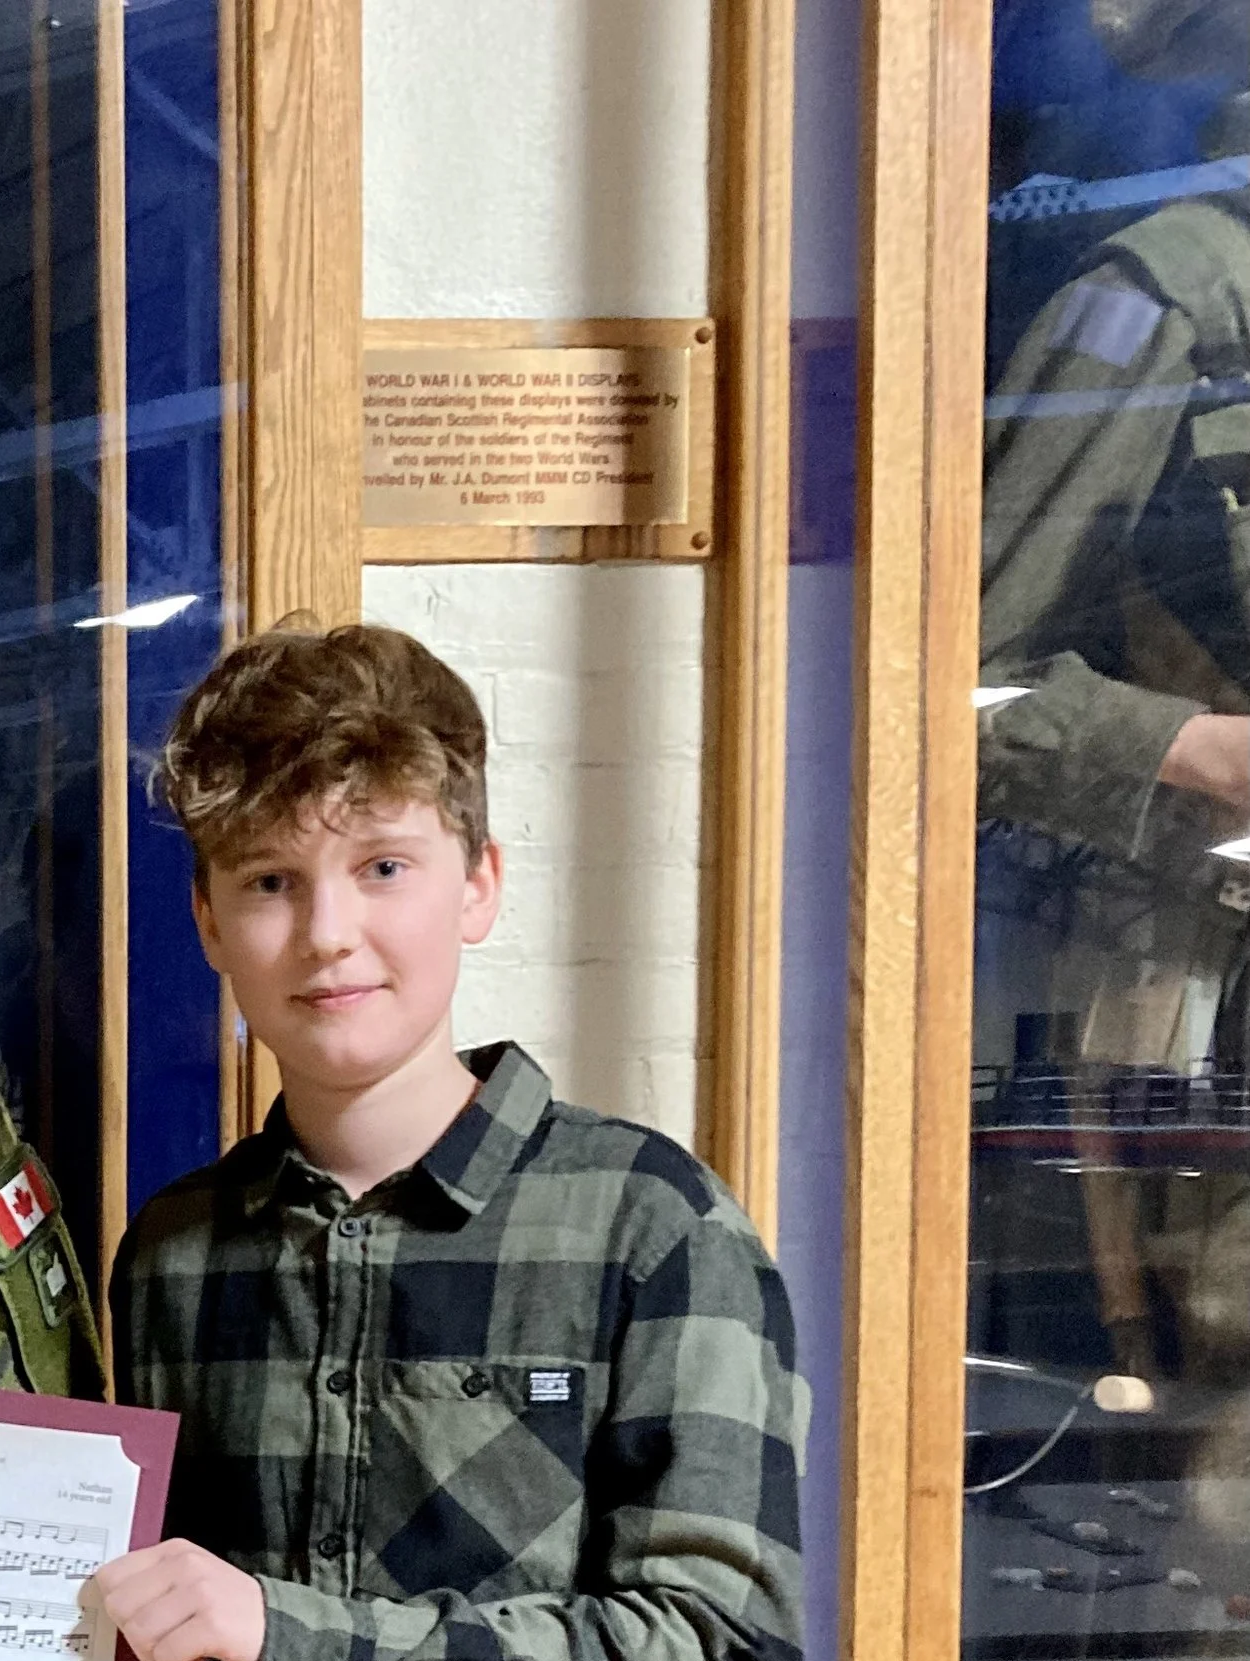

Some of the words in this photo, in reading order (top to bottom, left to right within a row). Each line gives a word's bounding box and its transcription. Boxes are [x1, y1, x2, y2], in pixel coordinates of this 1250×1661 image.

[365, 374, 415, 387] WORLD
[419, 374, 450, 387] WAR
[454, 374, 459, 387] I
[463, 374, 472, 387] &
[477, 374, 525, 387] WORLD
[530, 374, 561, 387] WAR
[566, 374, 573, 387] II
[578, 373, 639, 387] DISPLAYS
[362, 394, 407, 407] abinets
[411, 395, 476, 410] containing
[481, 395, 515, 407] these
[519, 393, 571, 410] displays
[575, 396, 607, 406] were
[664, 393, 679, 410] by
[363, 412, 380, 427] he
[385, 413, 442, 427] Canadian
[447, 412, 498, 427] Scottish
[502, 411, 573, 430] Regimental
[577, 412, 649, 426] Association
[372, 432, 384, 447] in
[390, 432, 432, 447] honour
[437, 432, 450, 447] of
[455, 432, 475, 447] the
[480, 432, 529, 447] soldiers
[533, 432, 547, 447] of
[551, 432, 570, 446] the
[575, 431, 634, 449] Regiment
[393, 453, 419, 467] who
[424, 452, 465, 467] served
[469, 452, 481, 466] in
[486, 452, 505, 467] the
[509, 452, 533, 466] two
[537, 451, 574, 466] World
[362, 472, 405, 487] nveiled
[410, 473, 425, 490] by
[430, 472, 448, 486] Mr.
[452, 472, 477, 486] J.A.
[481, 471, 530, 486] Dumont
[535, 471, 568, 485] MMM
[572, 471, 591, 485] CD
[595, 471, 654, 485] President
[472, 491, 510, 505] March
[516, 490, 546, 505] 1993
